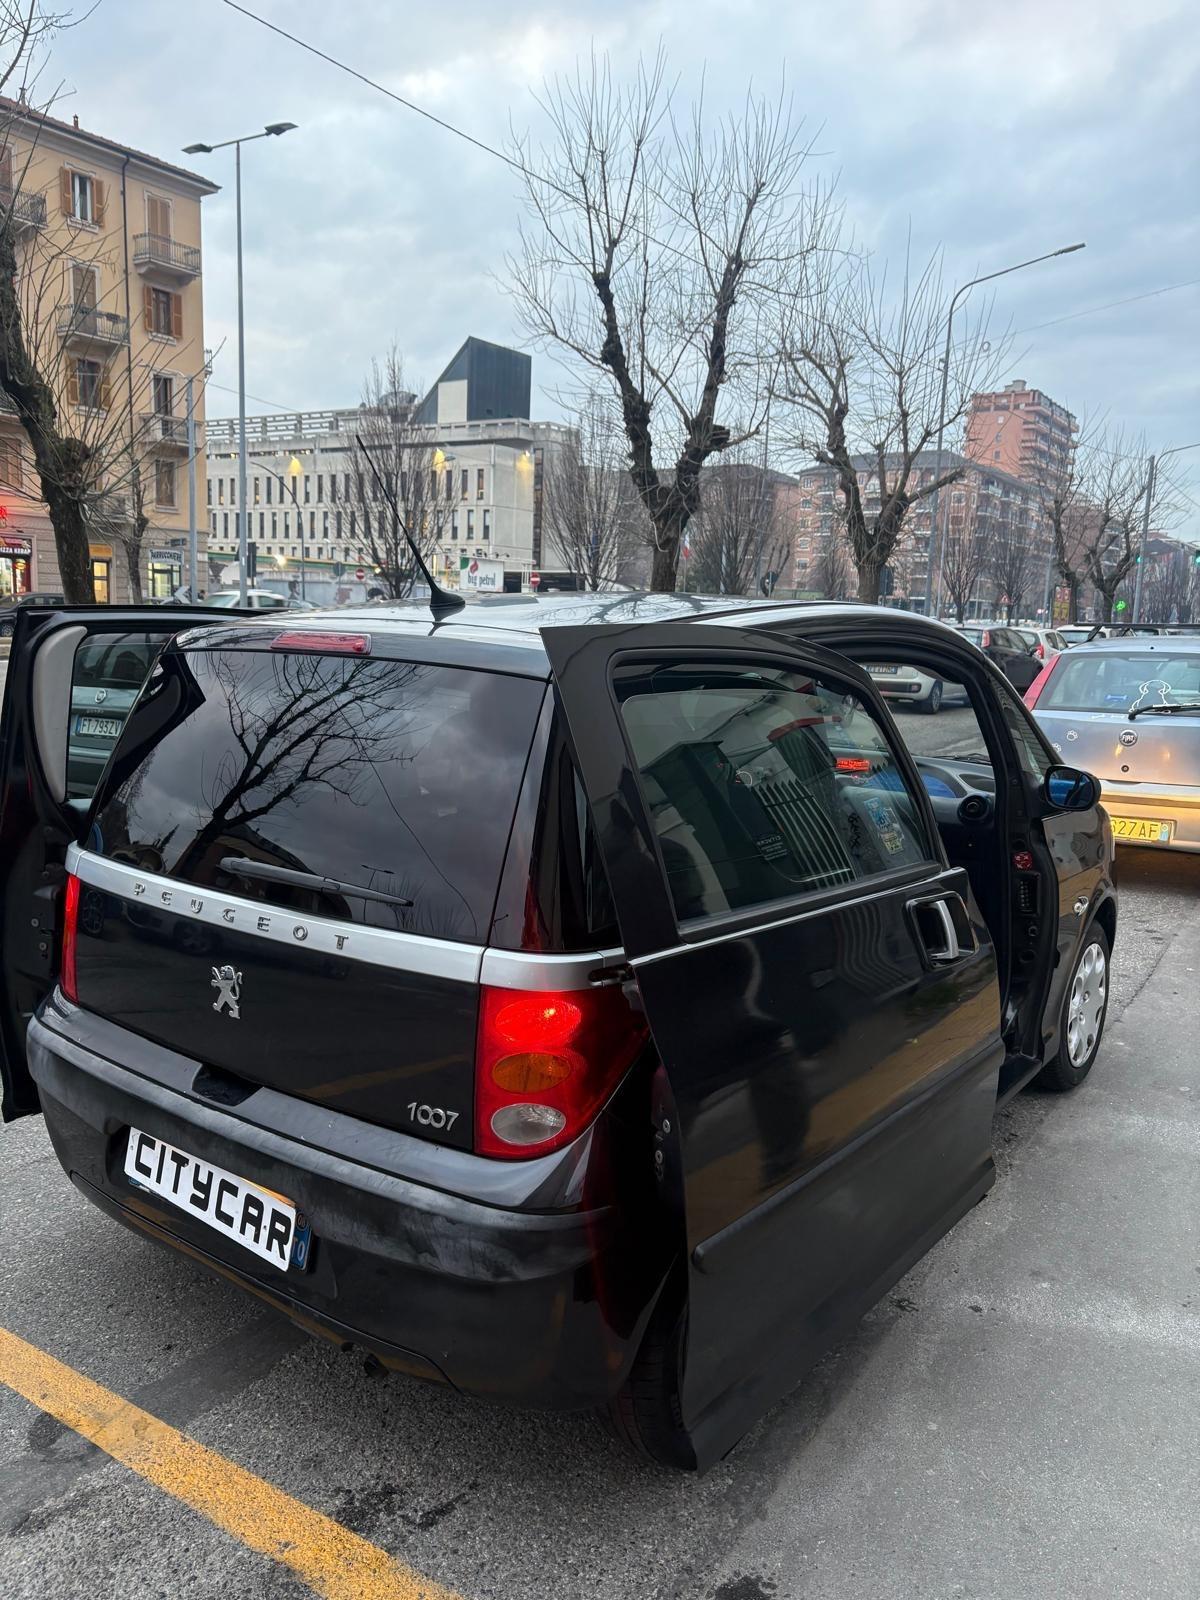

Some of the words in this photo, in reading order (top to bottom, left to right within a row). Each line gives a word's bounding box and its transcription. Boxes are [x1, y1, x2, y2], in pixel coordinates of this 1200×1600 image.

[133, 882, 349, 950] PEUGEOT
[407, 1102, 459, 1131] 1007
[134, 1133, 292, 1261] CITYCAR
